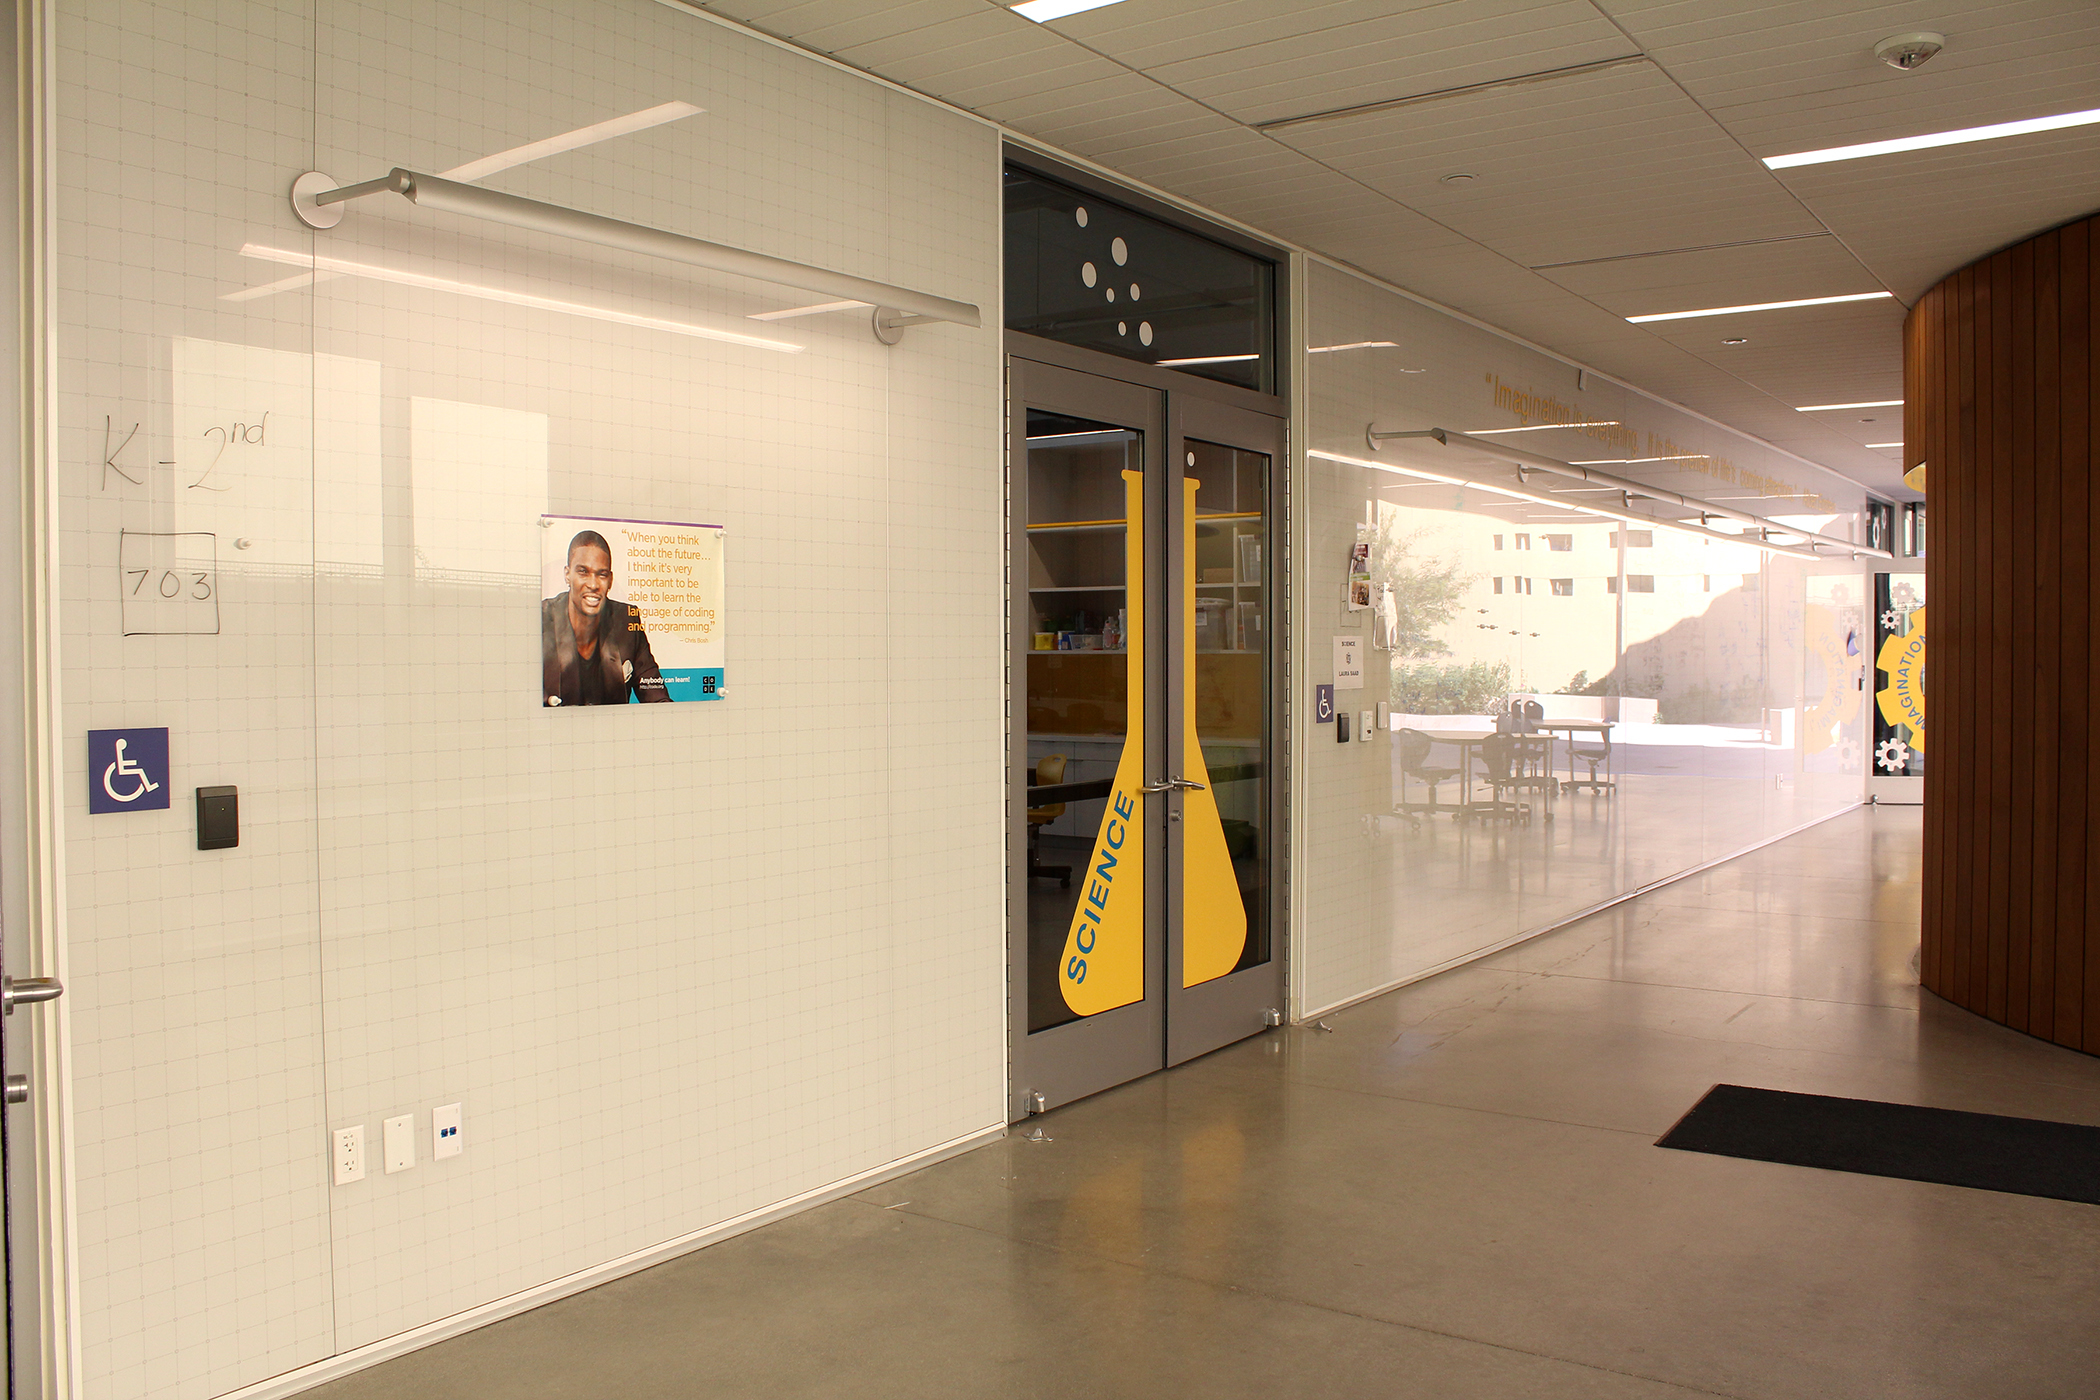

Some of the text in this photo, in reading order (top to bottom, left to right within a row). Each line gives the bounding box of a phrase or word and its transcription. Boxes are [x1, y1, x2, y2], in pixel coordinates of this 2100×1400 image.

[1574, 404, 1583, 433] is
[1587, 416, 1639, 458] everything.
[102, 415, 144, 491] K
[188, 411, 269, 492] 2nd
[658, 535, 675, 546] you
[677, 534, 699, 545] think
[627, 546, 656, 557] about
[657, 547, 673, 559] the
[627, 561, 631, 572] I
[633, 561, 657, 573] think
[673, 565, 693, 576] very
[128, 569, 211, 600] 703
[628, 576, 699, 589] important to be
[628, 591, 701, 603] able to learn the
[627, 605, 715, 619] language of coding
[627, 621, 647, 632] and
[640, 676, 664, 684] Anybody
[1067, 790, 1135, 985] SCIENCE
